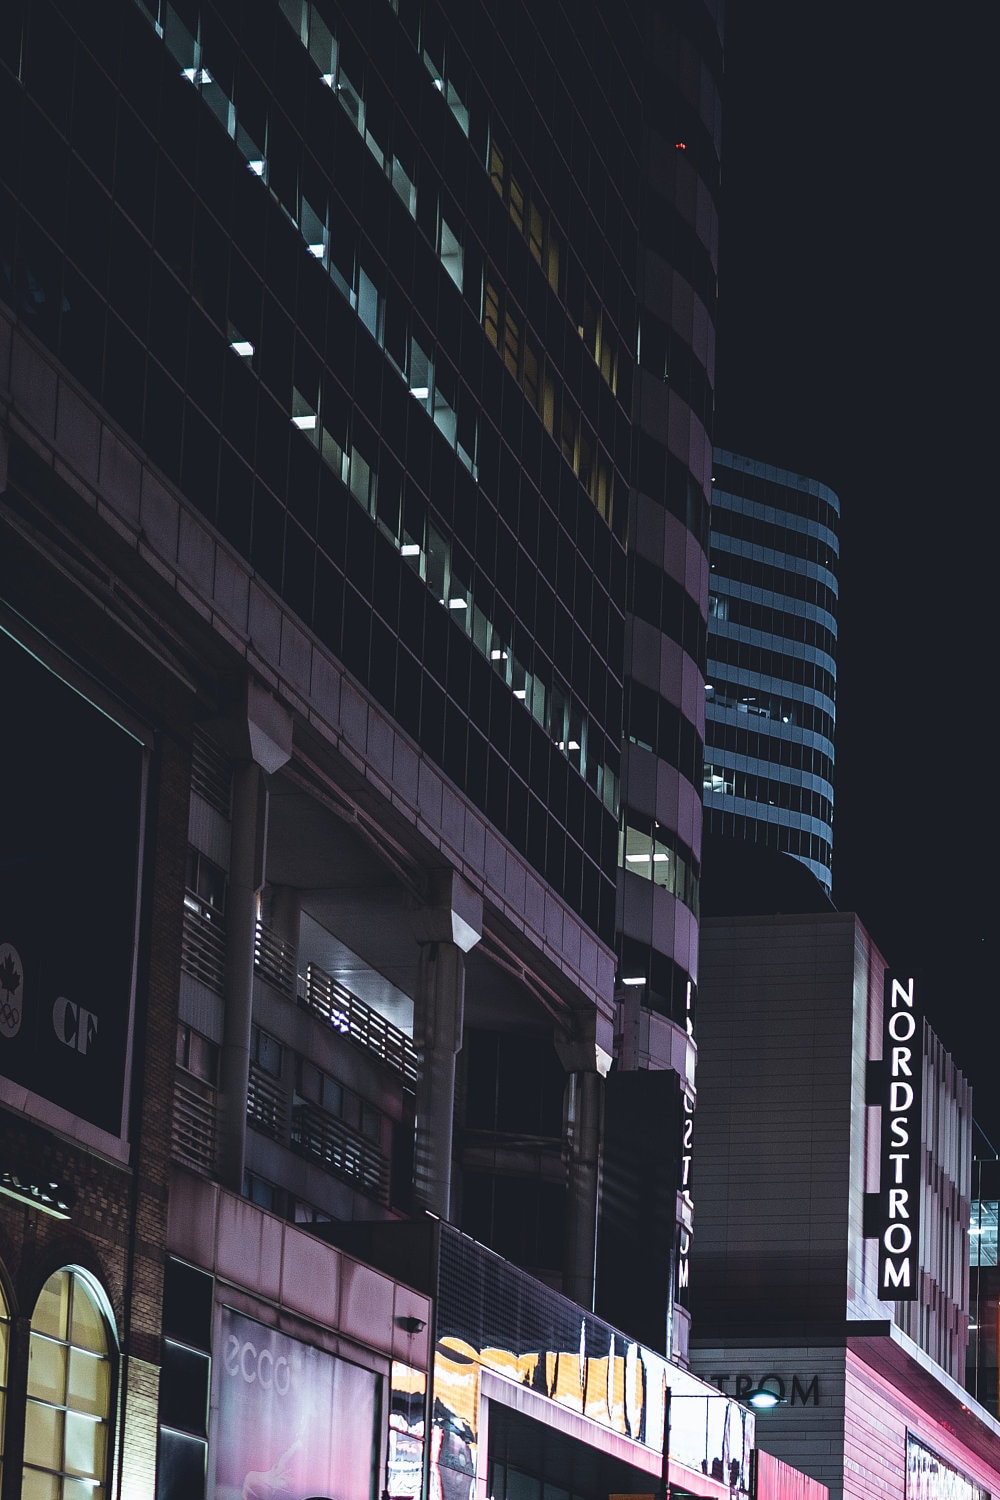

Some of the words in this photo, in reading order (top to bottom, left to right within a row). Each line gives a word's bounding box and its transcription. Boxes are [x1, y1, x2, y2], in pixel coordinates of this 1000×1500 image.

[52, 996, 99, 1055] CF
[883, 977, 916, 1288] NORDSTROM
[223, 1334, 290, 1396] ecco
[699, 1373, 819, 1406] TROM
